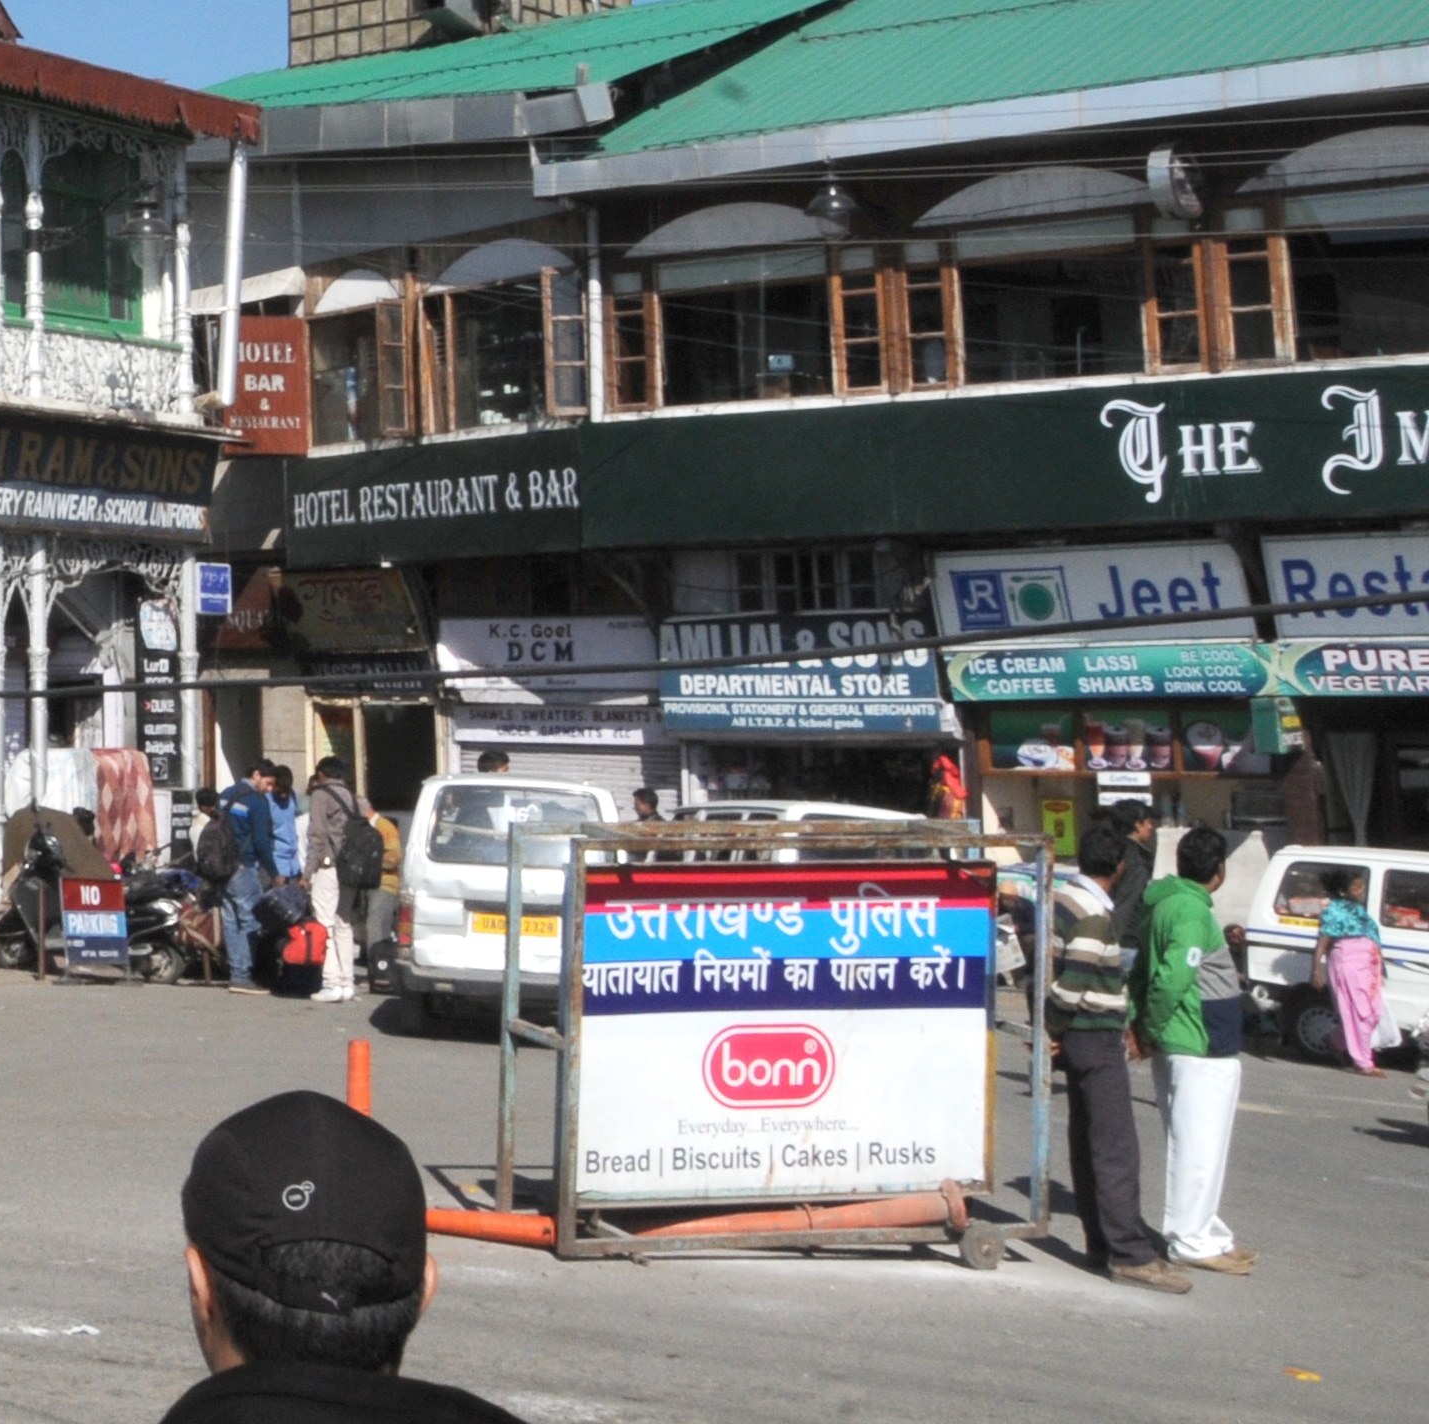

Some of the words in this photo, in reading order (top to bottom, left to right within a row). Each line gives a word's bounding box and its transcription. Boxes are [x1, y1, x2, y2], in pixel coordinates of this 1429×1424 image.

[244, 373, 286, 393] BAR
[258, 398, 271, 411] &
[229, 416, 302, 430] RESTAURANT
[16, 429, 98, 485] RAM
[119, 444, 207, 494] SONS
[1099, 398, 1263, 504] THE
[293, 488, 355, 528] HOTEL
[358, 474, 498, 523] RESTAURANT
[504, 472, 523, 512] &
[528, 467, 580, 510] BAR
[23, 490, 98, 522] RAINWEAR
[103, 497, 149, 526] SCHOOL
[149, 501, 212, 530] UNIFORMS
[963, 578, 1000, 611] JR
[1097, 560, 1223, 619] Jeet
[531, 623, 573, 639] Goel
[827, 619, 930, 668] SONS
[967, 659, 999, 675] ICE
[1001, 655, 1066, 675] CREAM
[1083, 654, 1139, 673] LASSI
[1179, 651, 1200, 663] BE
[1201, 649, 1240, 662] COOL
[1164, 665, 1203, 678] LOOK
[1204, 663, 1242, 677] COOL
[1322, 648, 1429, 672] PURE
[679, 673, 837, 697] DEPARTMENTAL
[840, 673, 911, 696] STORE
[985, 678, 1058, 695] COFFEE
[1078, 675, 1155, 694] SHAKES
[1162, 681, 1206, 694] DRINK
[1206, 679, 1247, 693] COOL
[468, 709, 514, 722] SHAWLS
[592, 710, 652, 723] BLANKETS
[663, 702, 731, 718] PROVISIONS,
[731, 702, 798, 718] STATIONERY
[798, 703, 809, 717] &
[809, 702, 864, 718] GENERAL
[864, 702, 937, 718] MERCHANTS
[797, 717, 833, 729] School
[833, 718, 866, 731] goods
[78, 884, 101, 906] NO
[67, 914, 118, 935] PARKING
[604, 897, 808, 941] उत्तराखण्ड
[829, 882, 940, 956] पुलिस
[581, 960, 683, 997] यातायात
[694, 947, 771, 993] नियमों
[783, 956, 818, 992] का
[830, 955, 899, 992] पालन
[720, 1041, 821, 1087] bonn
[585, 1148, 651, 1174] Bread
[672, 1145, 761, 1171] Biscuits
[781, 1142, 848, 1168] Cakes
[868, 1140, 936, 1166] Rusks
